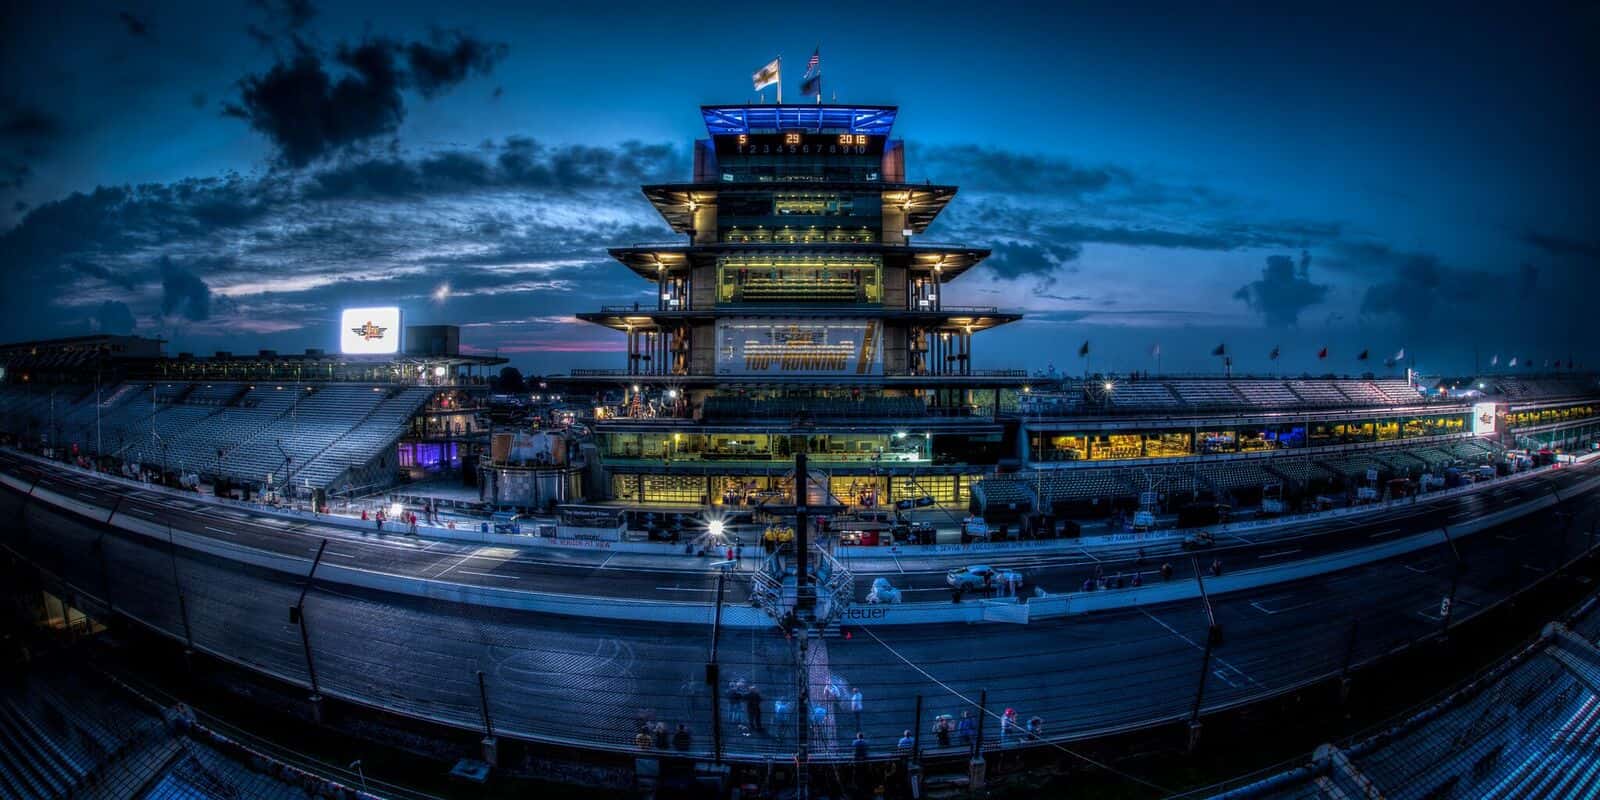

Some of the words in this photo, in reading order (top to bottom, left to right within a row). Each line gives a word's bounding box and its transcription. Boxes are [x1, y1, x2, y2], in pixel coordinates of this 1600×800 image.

[739, 134, 747, 144] 5
[786, 134, 800, 144] 29
[750, 145, 757, 154] 2
[763, 145, 770, 154] 3
[776, 145, 783, 154] 4
[790, 145, 797, 154] 5
[803, 145, 810, 154] 6
[816, 145, 823, 154] 7
[829, 145, 836, 154] 8
[843, 145, 849, 154] 9
[855, 145, 866, 154] 10
[781, 353, 848, 370] RUNNING
